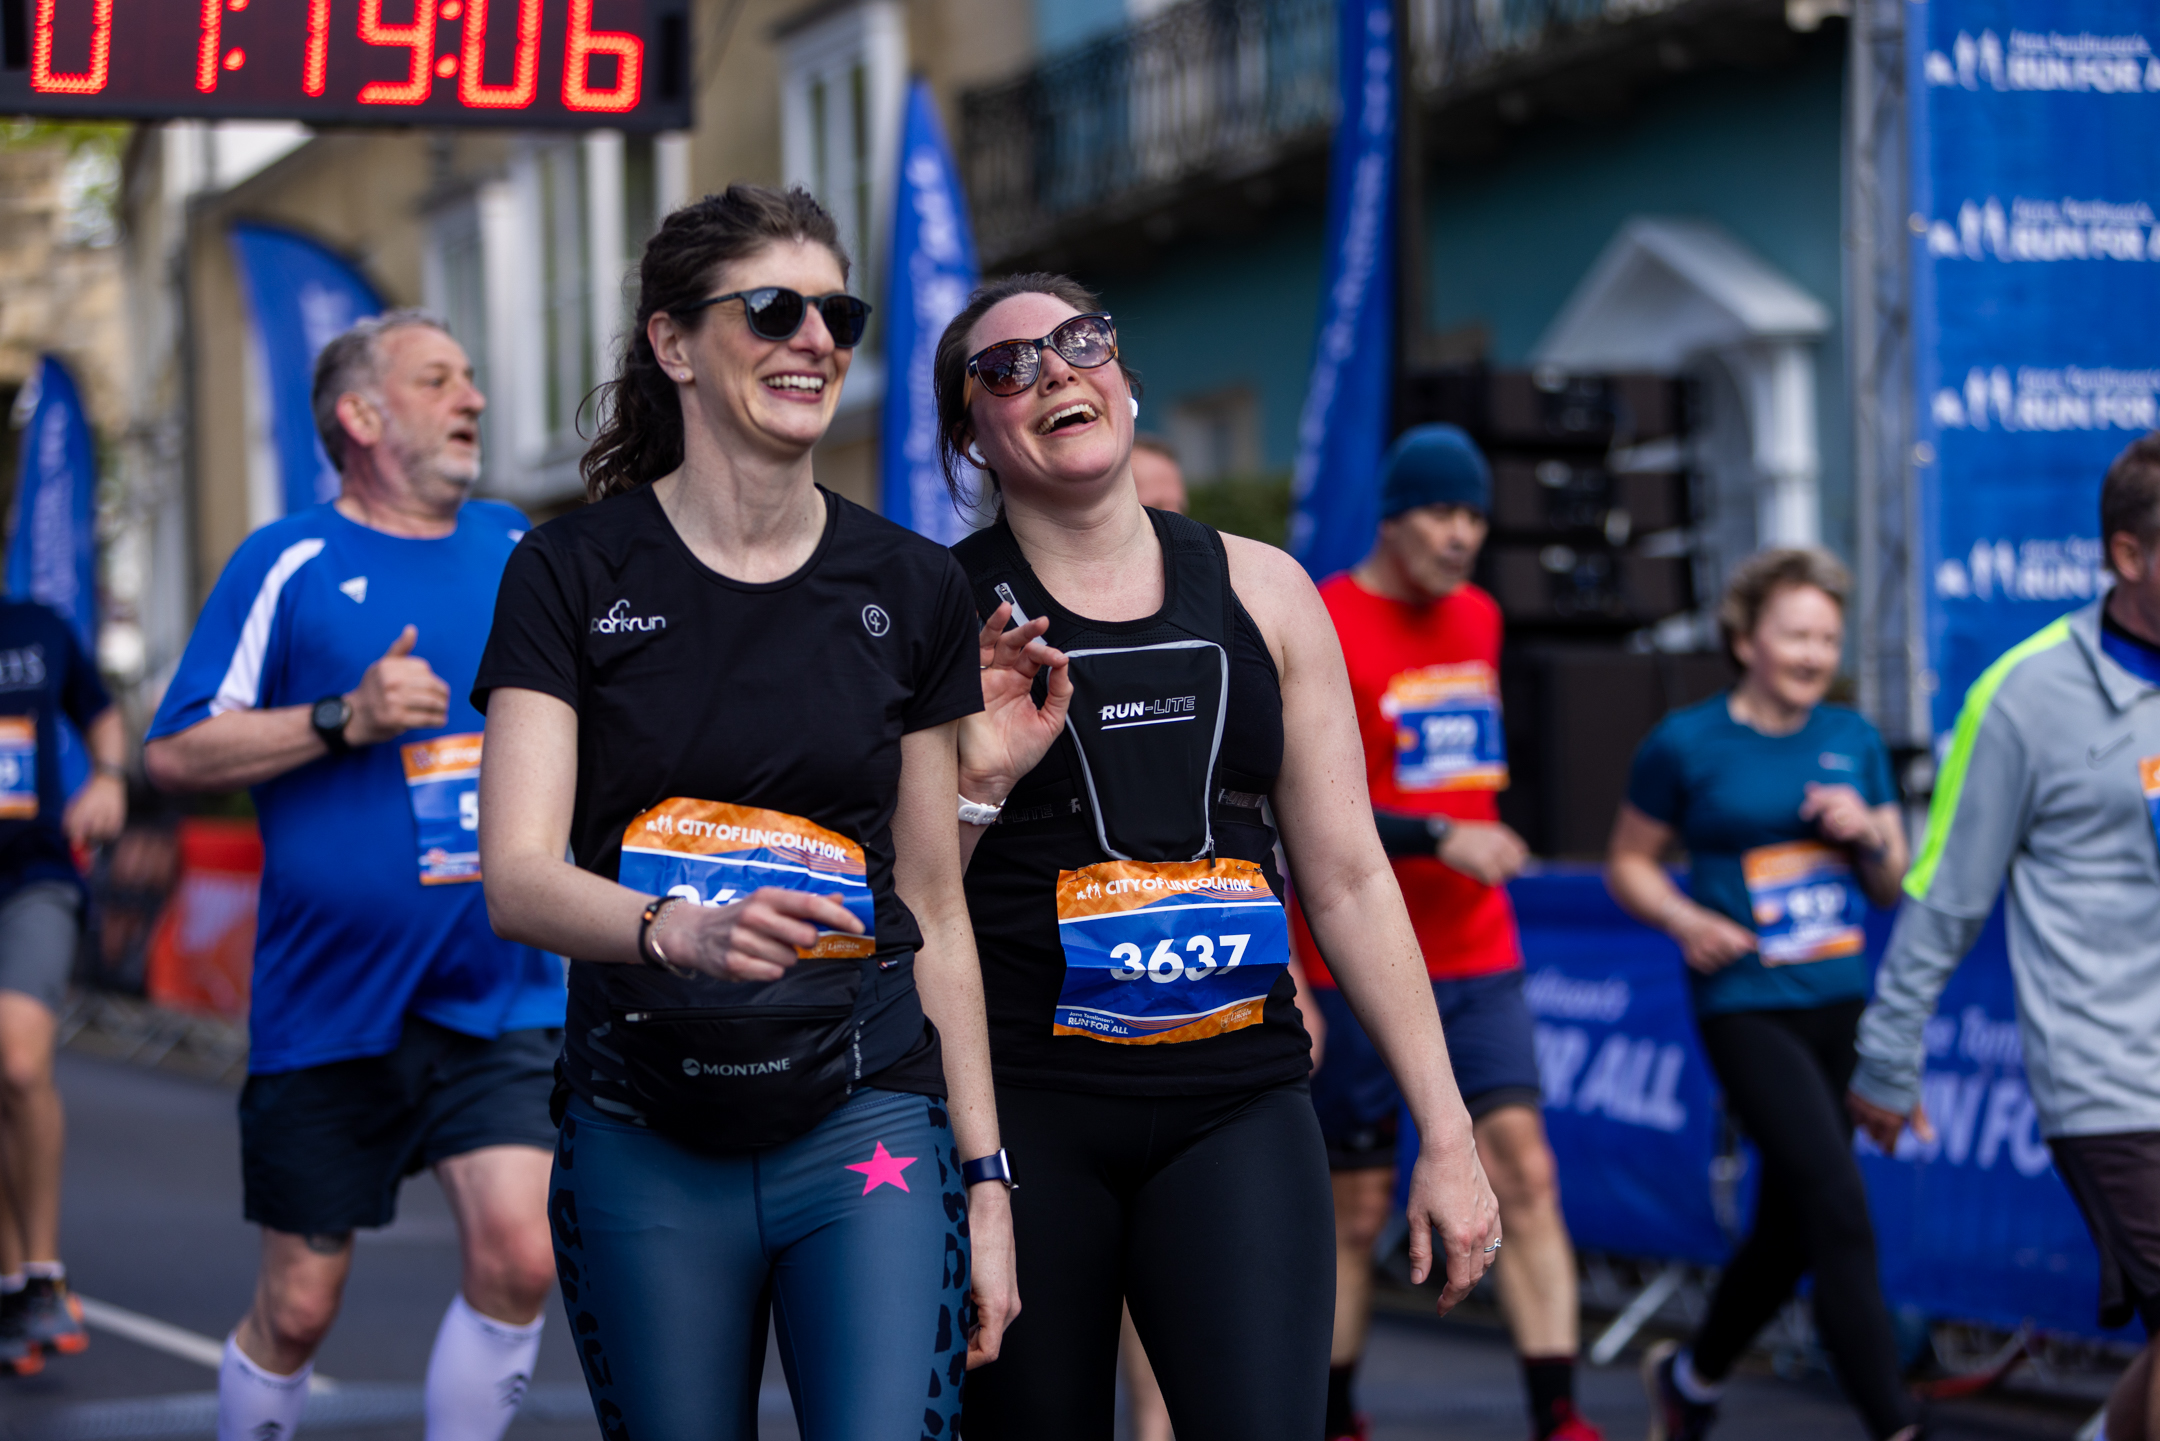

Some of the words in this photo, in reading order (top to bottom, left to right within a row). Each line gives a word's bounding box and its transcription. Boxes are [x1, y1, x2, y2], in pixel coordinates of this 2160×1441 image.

[589, 600, 666, 634] parkrun
[1100, 696, 1196, 720] RUN-LITE
[1110, 934, 1251, 984] 3637
[1068, 1017, 1089, 1027] RUN
[1090, 1020, 1110, 1032] FOR
[1111, 1025, 1129, 1035] ALL
[703, 1058, 791, 1076] MONTANE
